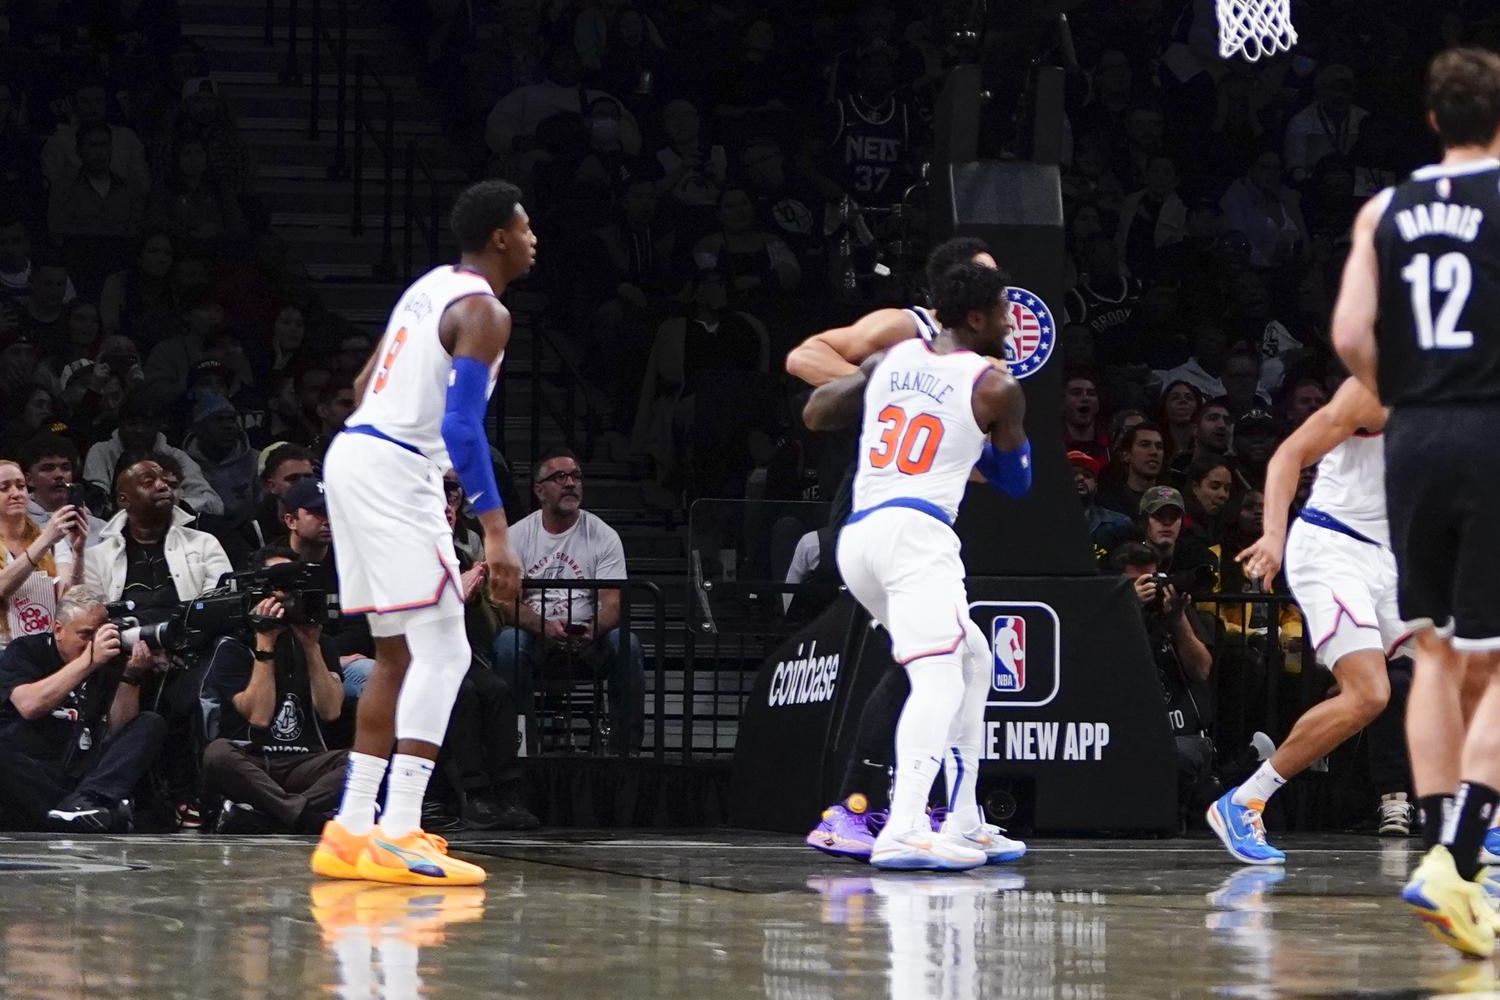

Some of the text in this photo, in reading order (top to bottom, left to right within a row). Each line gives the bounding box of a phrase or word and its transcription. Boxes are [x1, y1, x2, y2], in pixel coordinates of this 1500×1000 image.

[845, 135, 901, 163] NETS
[855, 164, 892, 193] 37
[1394, 202, 1484, 242] HARRIS
[1400, 252, 1474, 350] 12
[890, 371, 954, 404] RANDLE
[869, 404, 945, 476] 30
[768, 640, 840, 707] coinbase
[996, 674, 1013, 687] NBA
[1004, 721, 1060, 761] NEW
[1063, 722, 1110, 761] APP
